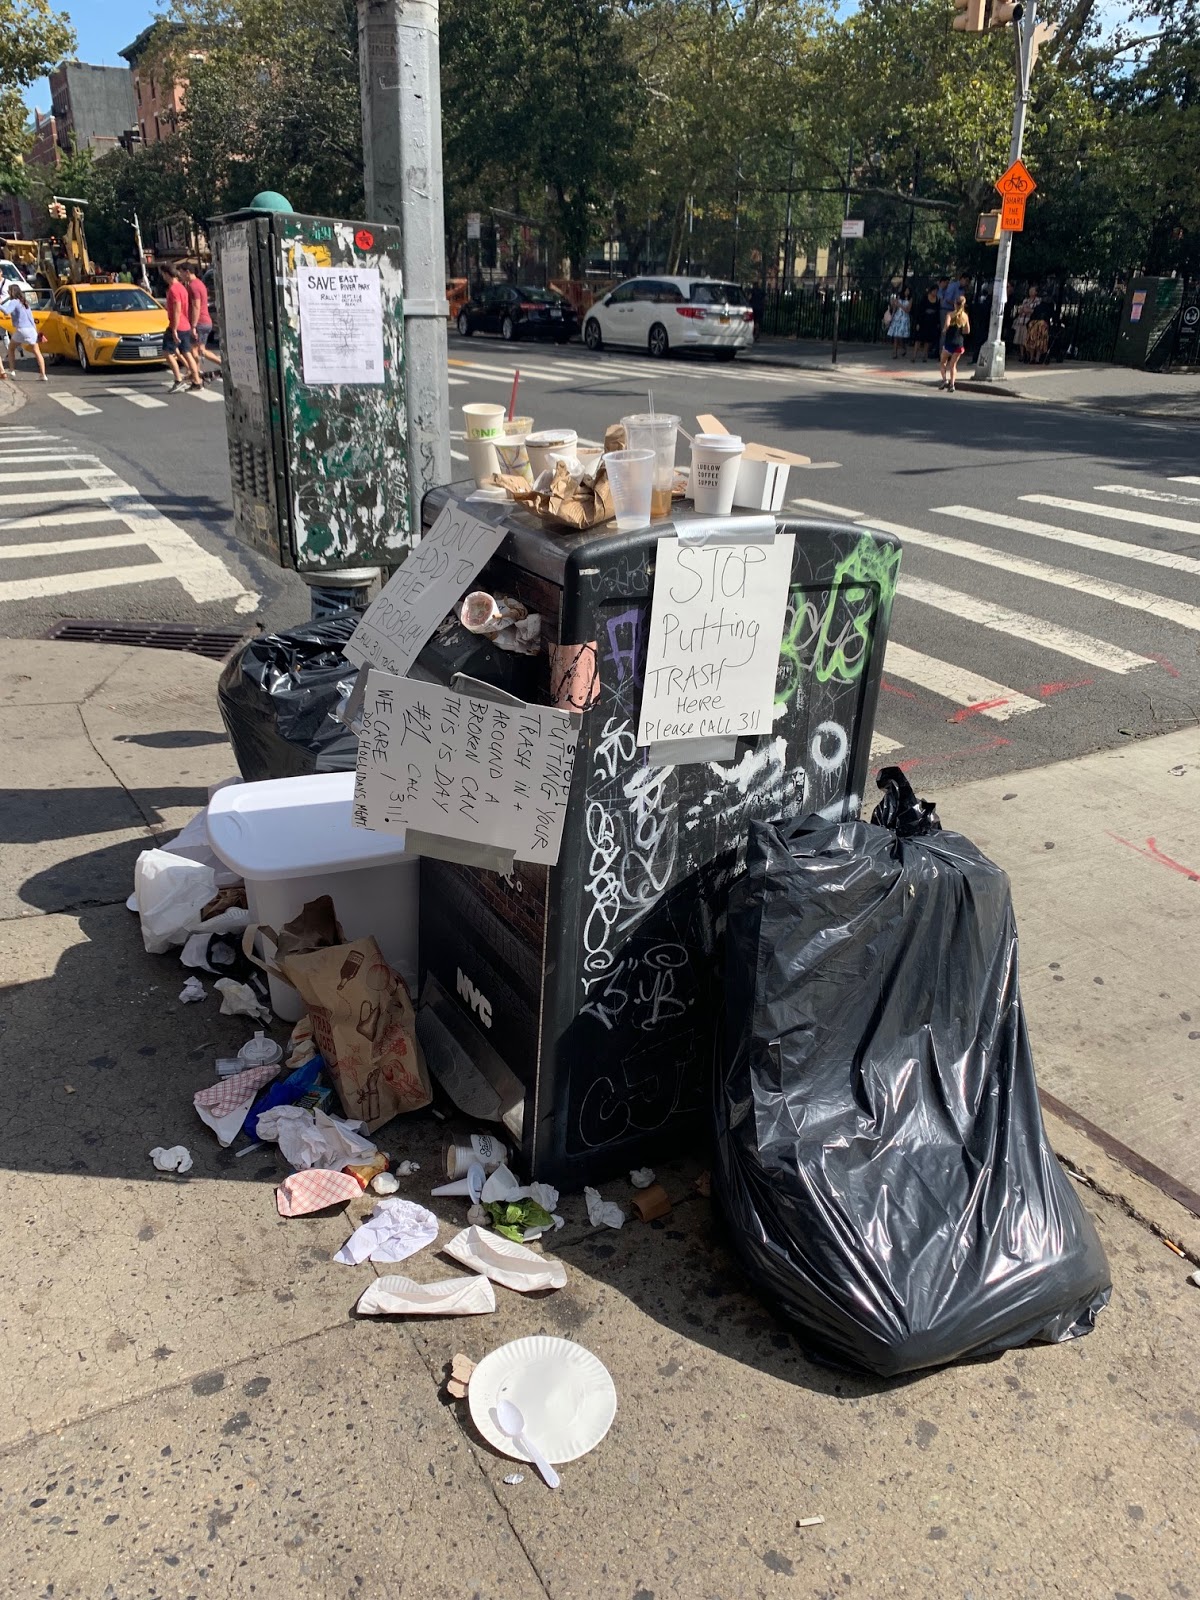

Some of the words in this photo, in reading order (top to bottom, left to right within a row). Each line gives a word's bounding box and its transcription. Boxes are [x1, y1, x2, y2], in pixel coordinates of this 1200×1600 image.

[1006, 197, 1023, 205] SHARE
[1009, 207, 1018, 215] THE
[1006, 218, 1020, 226] ROAD
[308, 275, 337, 291] SAVE
[339, 275, 359, 283] EAST
[697, 464, 721, 472] LUDLOW
[698, 471, 719, 479] COFFEE
[698, 479, 719, 487] SUPPLY
[410, 547, 449, 581] ADD
[448, 559, 475, 585] TO
[670, 546, 767, 604] STOP
[390, 569, 425, 606] THE
[355, 627, 370, 649] CALL
[662, 607, 761, 668] Putting
[648, 658, 726, 698] TRASH
[374, 688, 394, 715] WE
[361, 711, 373, 735] DOC
[645, 719, 694, 740] Please
[699, 717, 732, 736] CALL
[737, 709, 761, 730] 311
[488, 709, 511, 779] AROUND
[514, 714, 542, 770] TRASH
[540, 714, 571, 800] PUTTING
[406, 763, 423, 801] CALL
[432, 764, 455, 814] DAY
[459, 776, 480, 824] CAN
[484, 792, 500, 804] A
[531, 807, 557, 850] YOUR
[456, 965, 493, 1029] NYC
